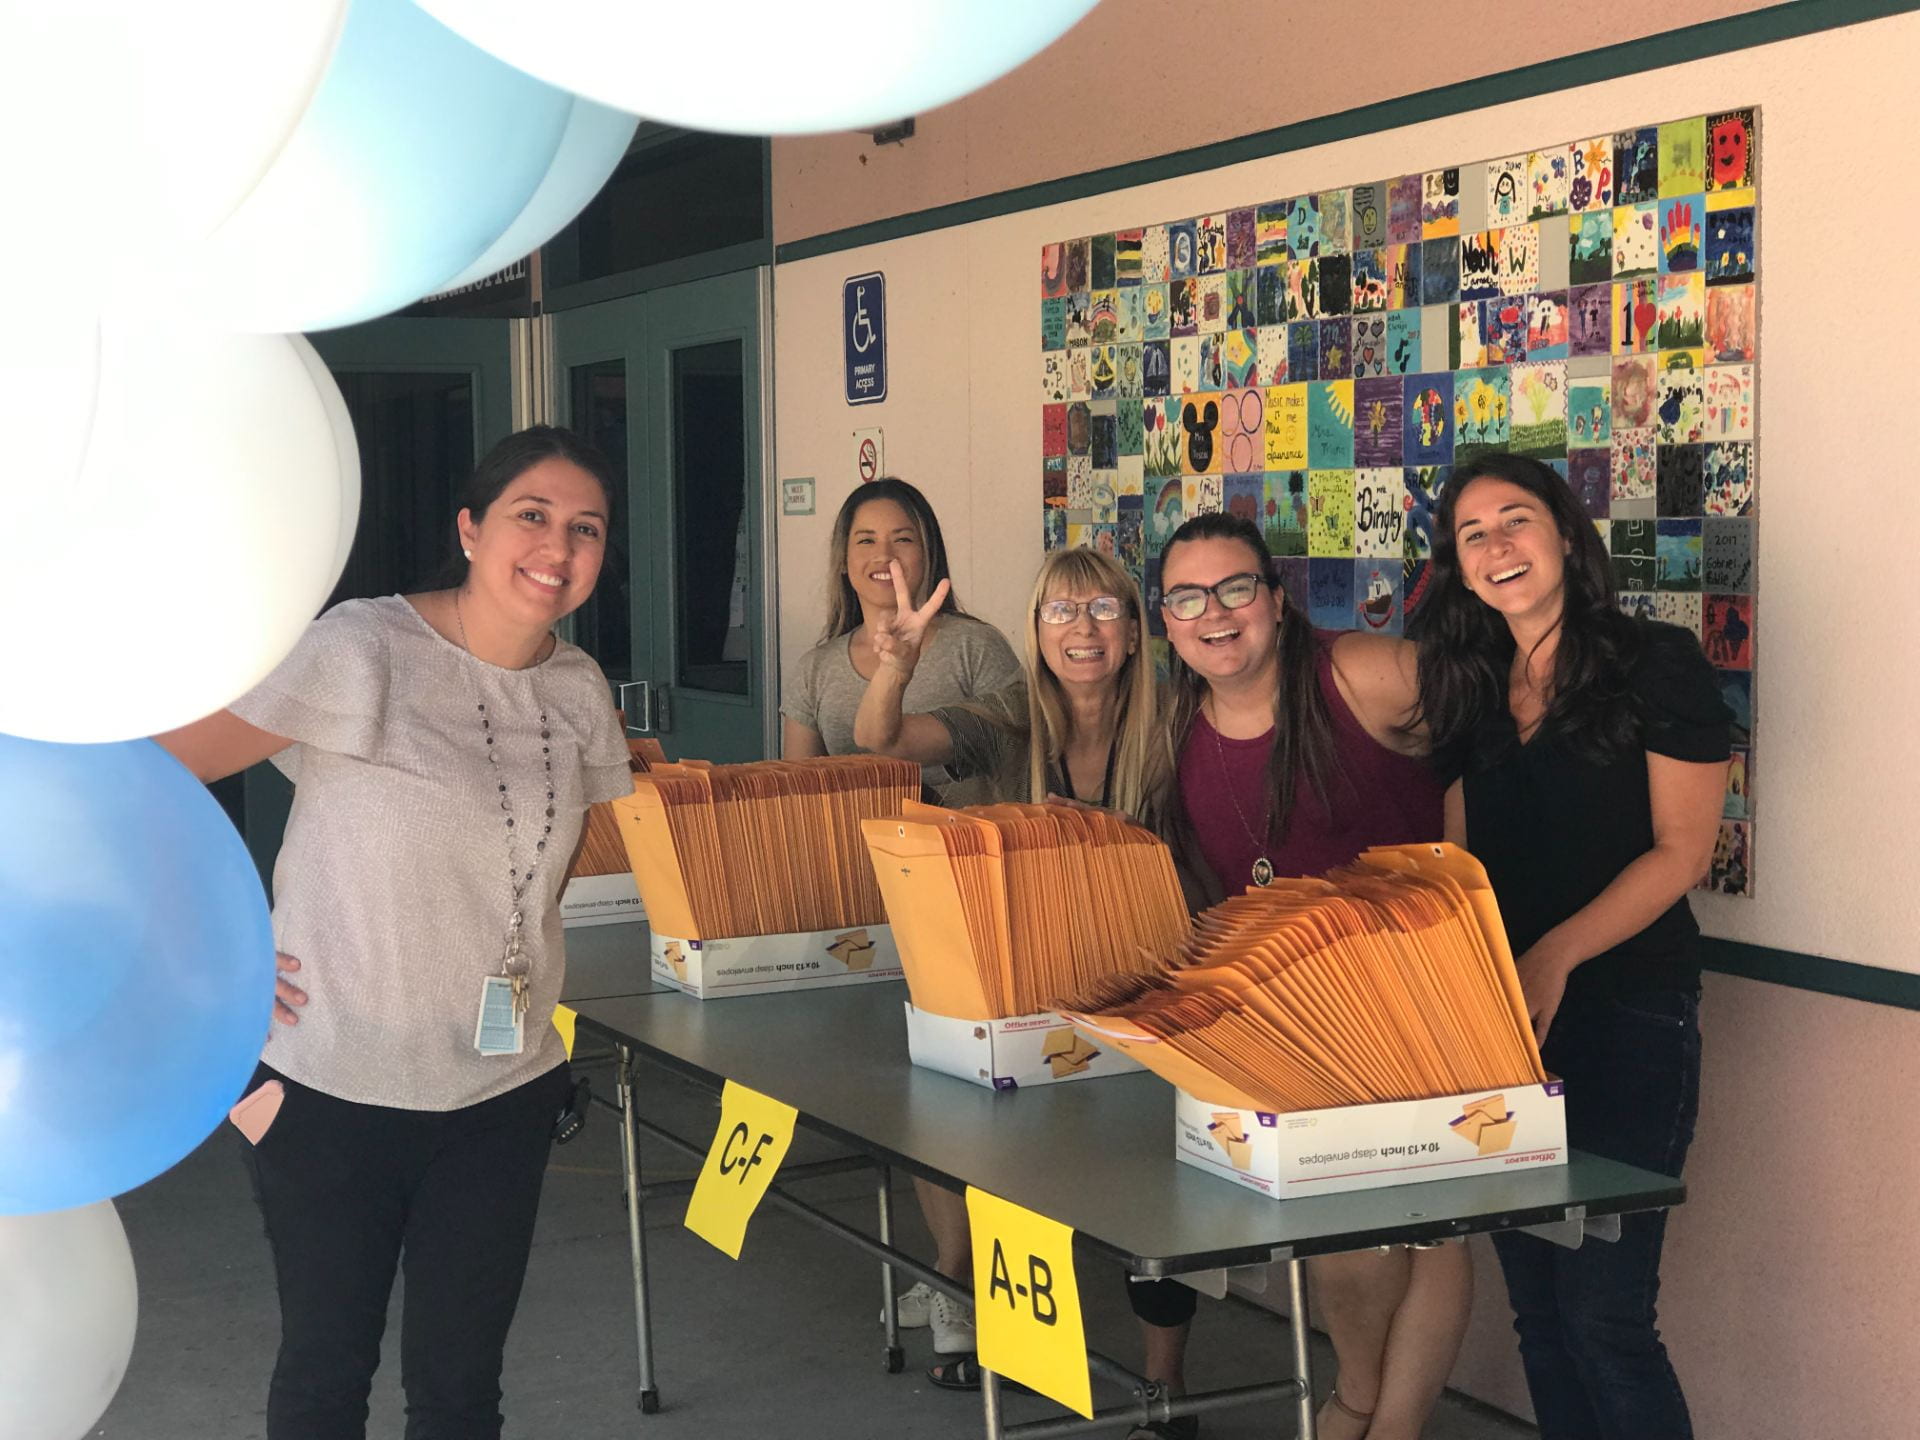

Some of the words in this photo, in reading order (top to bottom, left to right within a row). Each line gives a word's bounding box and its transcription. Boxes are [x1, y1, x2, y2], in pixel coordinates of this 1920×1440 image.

[854, 363, 876, 376] PRIMARY
[855, 377, 875, 390] ACCESS
[1357, 487, 1403, 545] Bingley
[1714, 534, 1737, 546] 2017
[716, 967, 754, 977] envelopes
[776, 964, 795, 972] inch
[1004, 1020, 1028, 1029] Office
[719, 1121, 774, 1185] C-F
[1351, 1147, 1378, 1161] clasp
[1381, 1145, 1406, 1158] inch
[1407, 1144, 1420, 1155] 13
[1428, 1141, 1441, 1154] 10
[1298, 1151, 1350, 1166] envelopes
[1531, 1152, 1556, 1163] Office
[989, 1237, 1058, 1327] A-B
